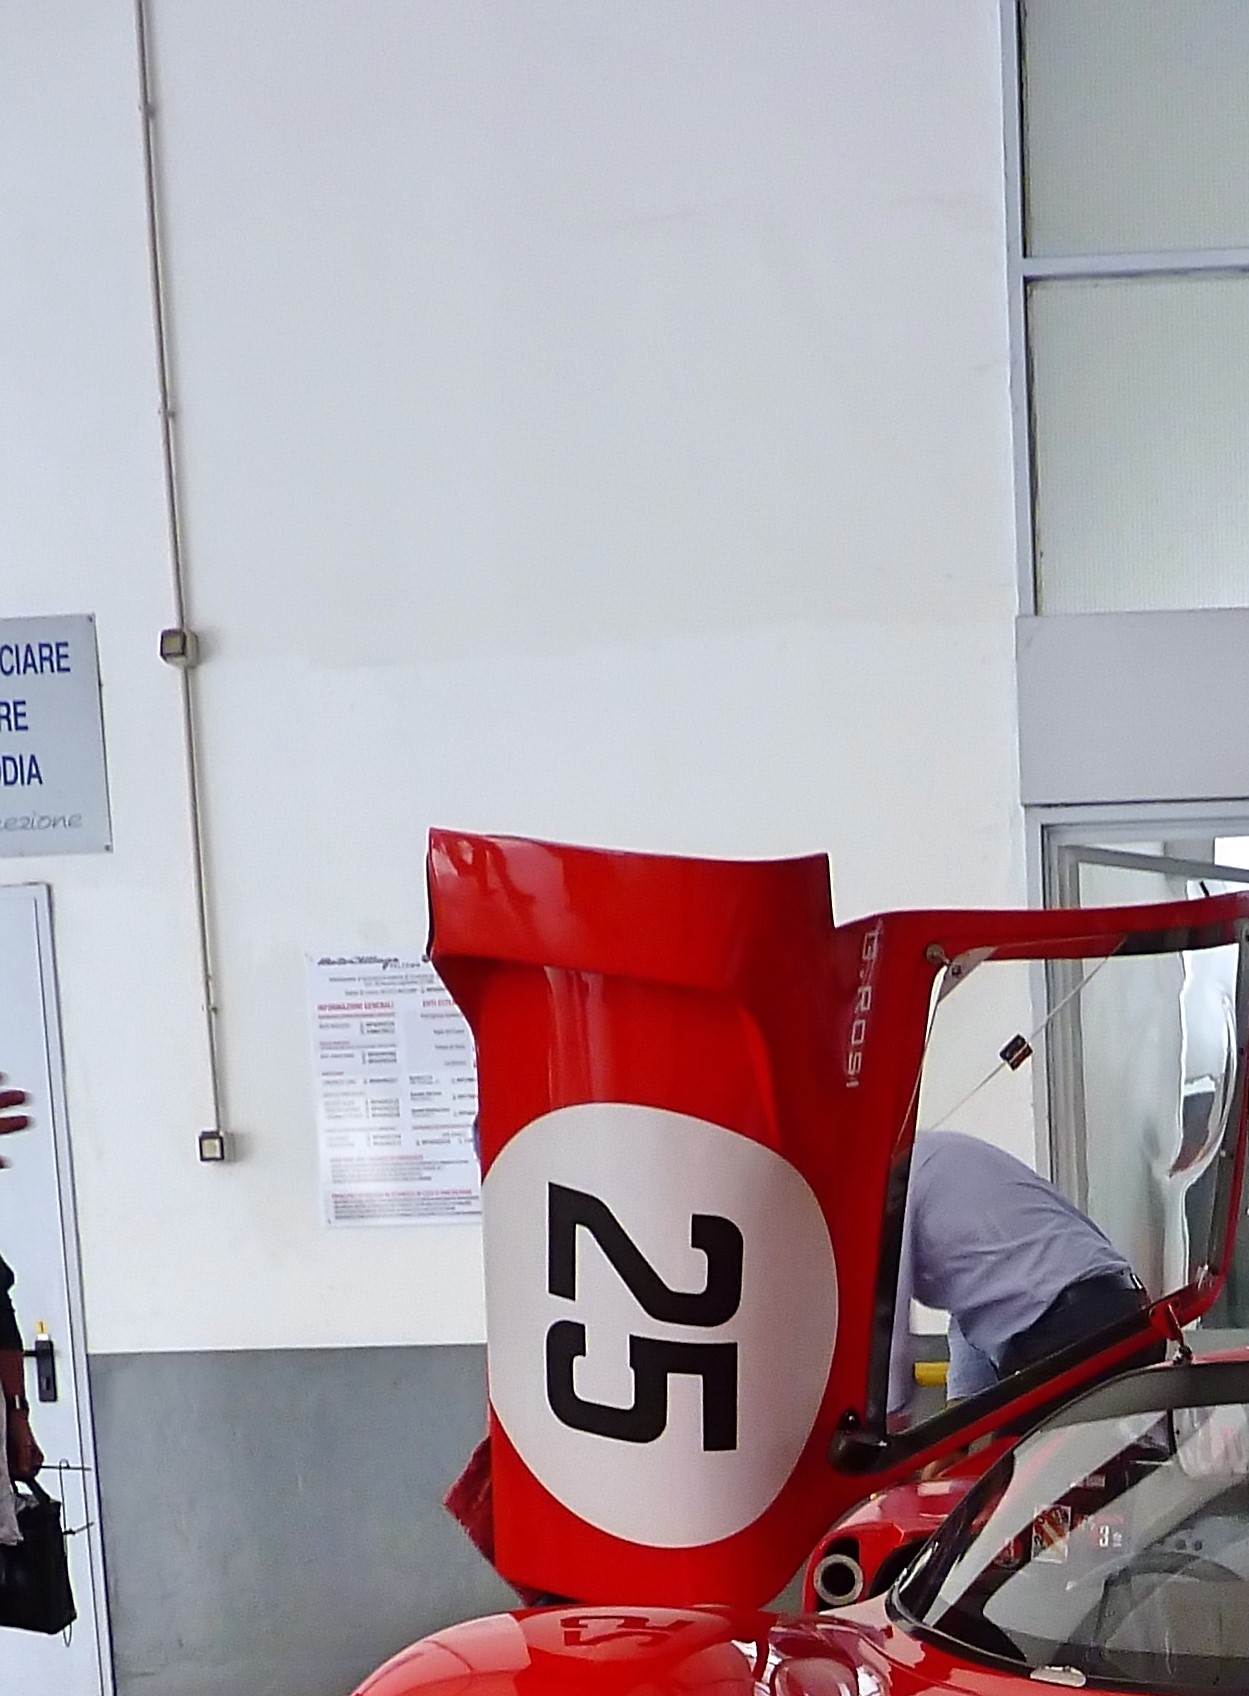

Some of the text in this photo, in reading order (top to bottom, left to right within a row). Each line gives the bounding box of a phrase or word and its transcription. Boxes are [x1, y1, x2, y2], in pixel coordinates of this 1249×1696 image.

[0, 641, 71, 676] CIARE
[0, 700, 28, 732] RE
[0, 754, 43, 786] DIA
[0, 810, 82, 831] ezione
[546, 1182, 744, 1452] 25
